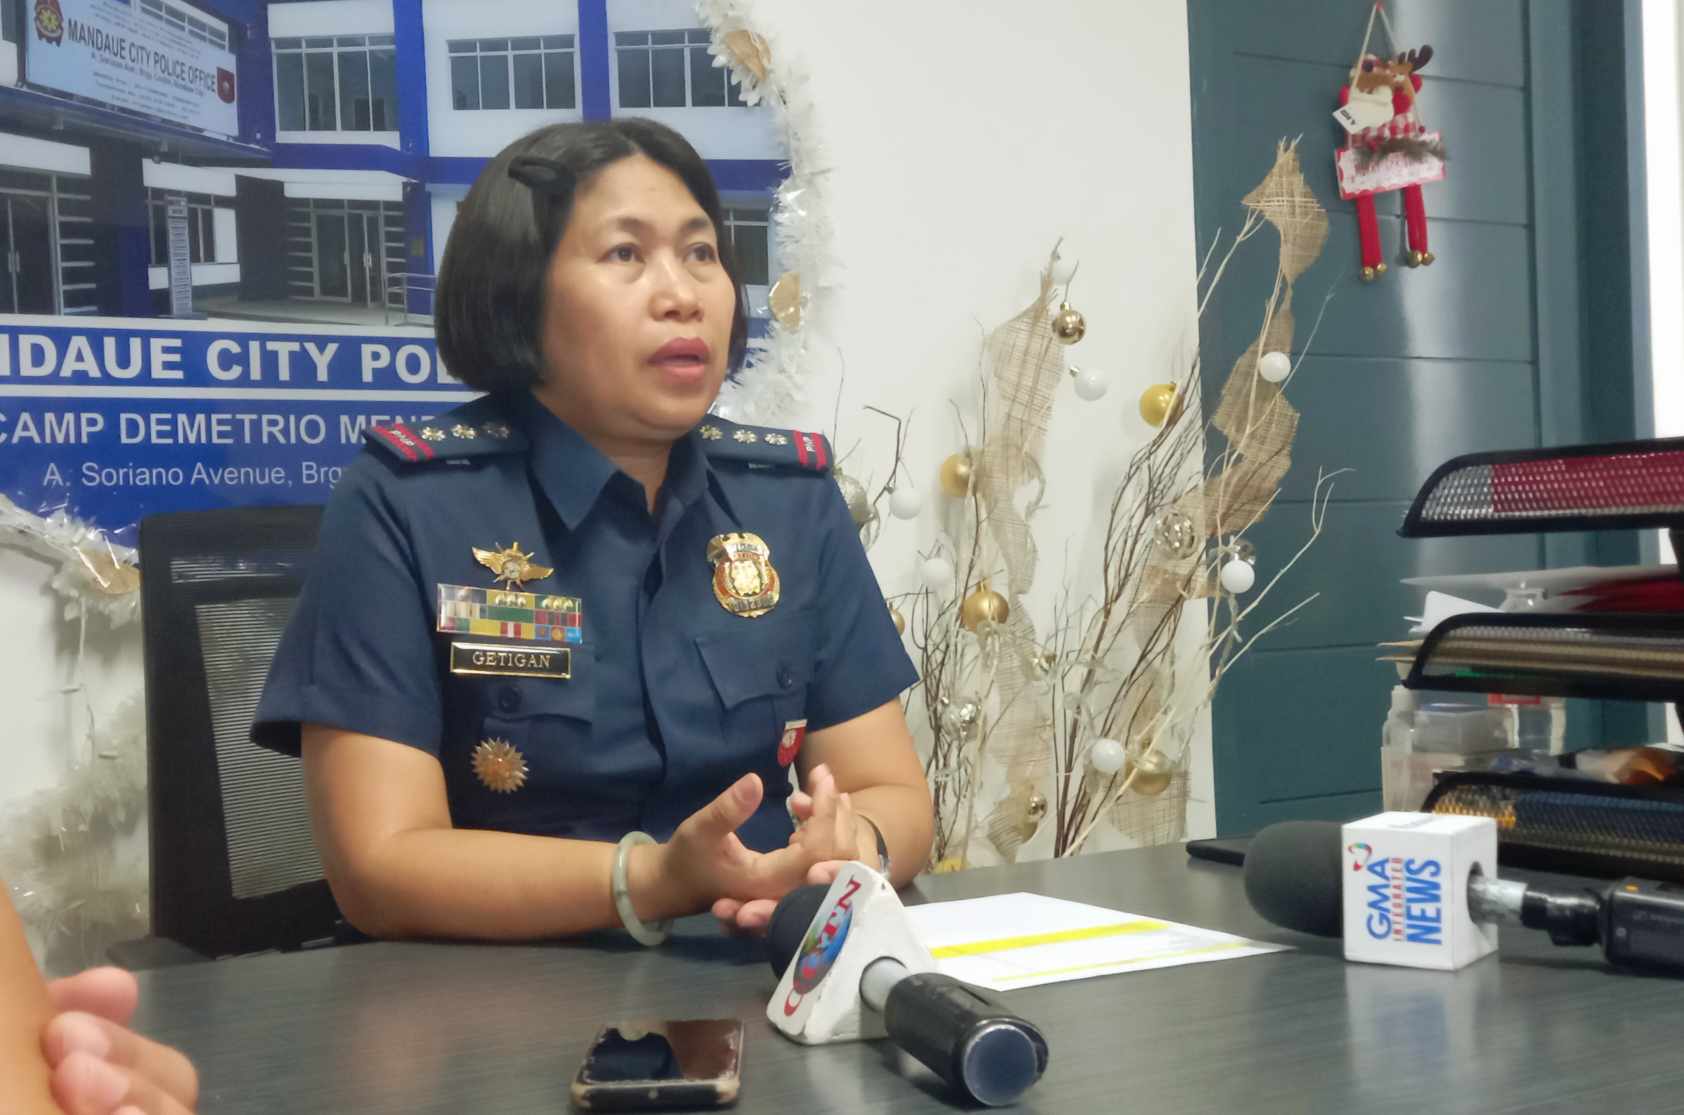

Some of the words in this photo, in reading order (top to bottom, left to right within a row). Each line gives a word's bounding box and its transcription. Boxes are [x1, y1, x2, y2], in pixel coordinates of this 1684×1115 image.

[67, 18, 126, 63] MANDAUE
[128, 42, 151, 66] CITY
[153, 51, 186, 82] POLICE
[187, 66, 216, 93] OFFICE
[207, 338, 340, 382] CITY
[119, 412, 326, 445] DEMETRIO
[43, 462, 71, 487] A.
[81, 462, 184, 486] Soriano
[191, 463, 292, 488] Avenue,
[472, 651, 551, 668] GETIGAN
[1366, 857, 1392, 940] GMA
[1404, 858, 1442, 945] NEWS
